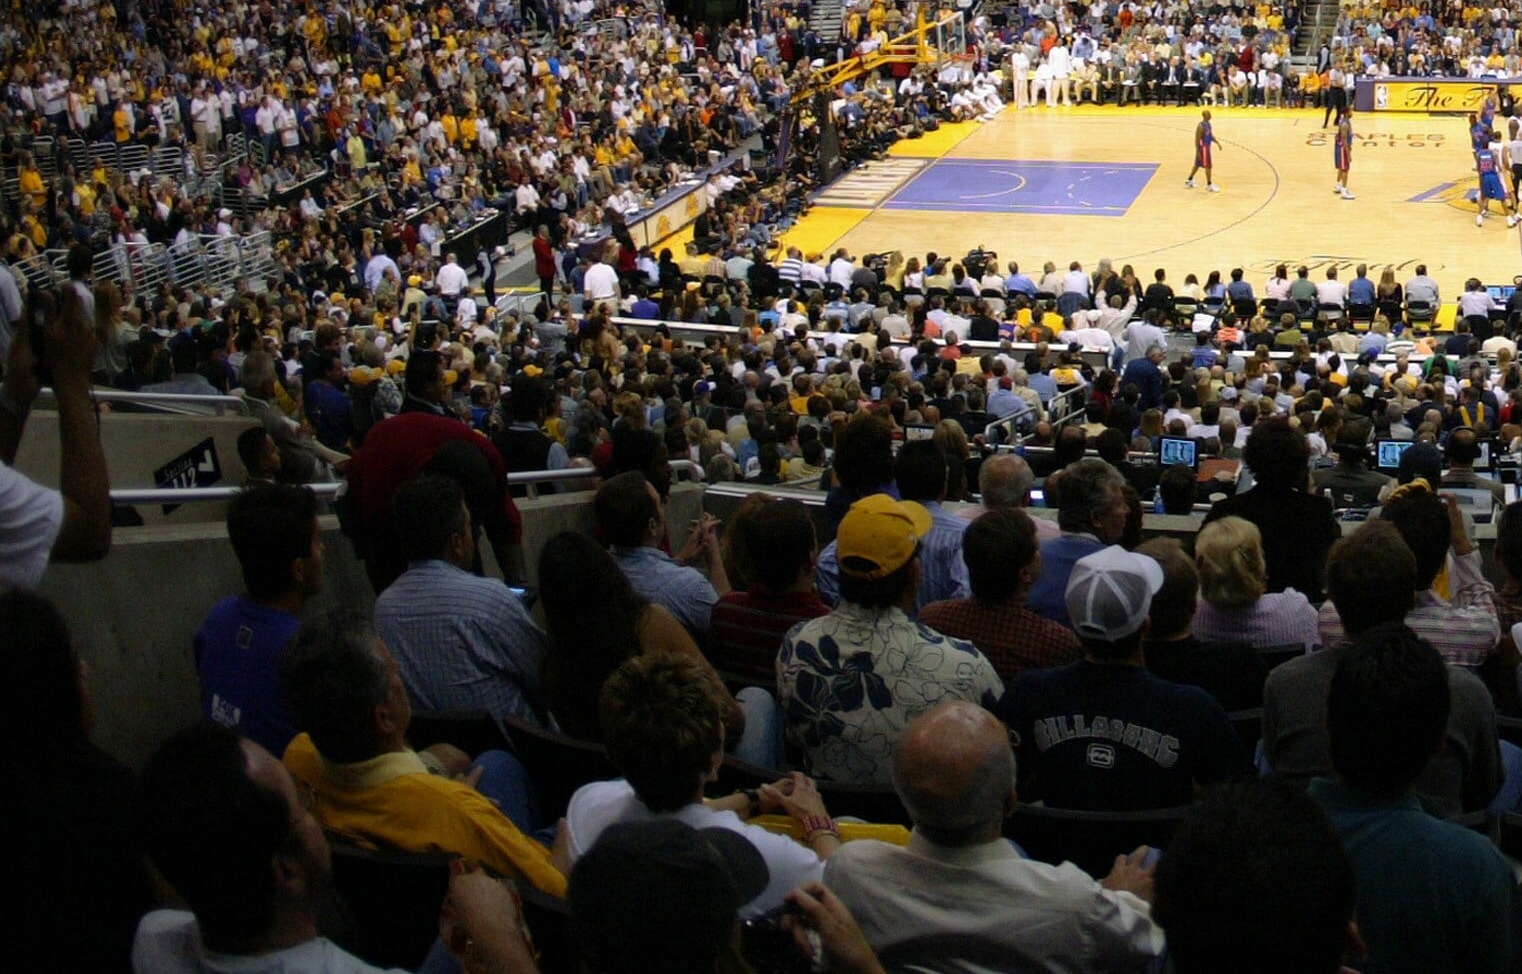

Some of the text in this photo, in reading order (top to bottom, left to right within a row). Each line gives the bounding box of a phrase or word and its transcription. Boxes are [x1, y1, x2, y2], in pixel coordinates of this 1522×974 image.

[1404, 86, 1451, 108] The
[1306, 139, 1445, 148] Cnter
[1034, 714, 1181, 768] BILLABONG
